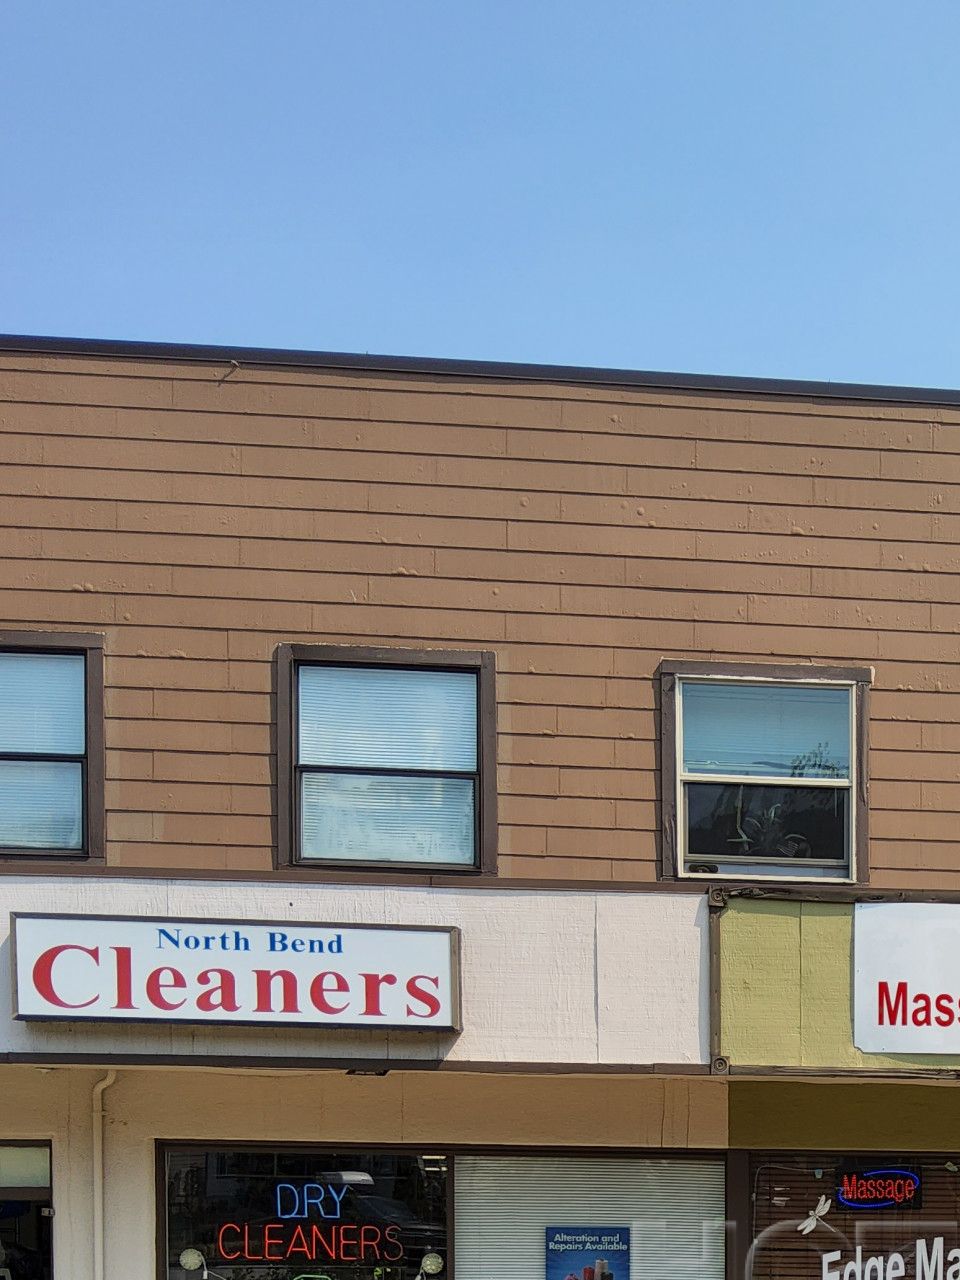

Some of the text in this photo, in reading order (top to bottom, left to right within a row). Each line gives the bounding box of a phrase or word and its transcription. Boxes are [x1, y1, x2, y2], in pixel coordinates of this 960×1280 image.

[155, 928, 344, 954] North Bend
[32, 943, 441, 1018] Cleaners
[276, 1183, 348, 1219] DRY
[841, 1173, 917, 1202] Massage
[218, 1223, 404, 1261] CLEANERS
[548, 1242, 628, 1252] Repairs Available
[554, 1233, 620, 1242] Alteration and
